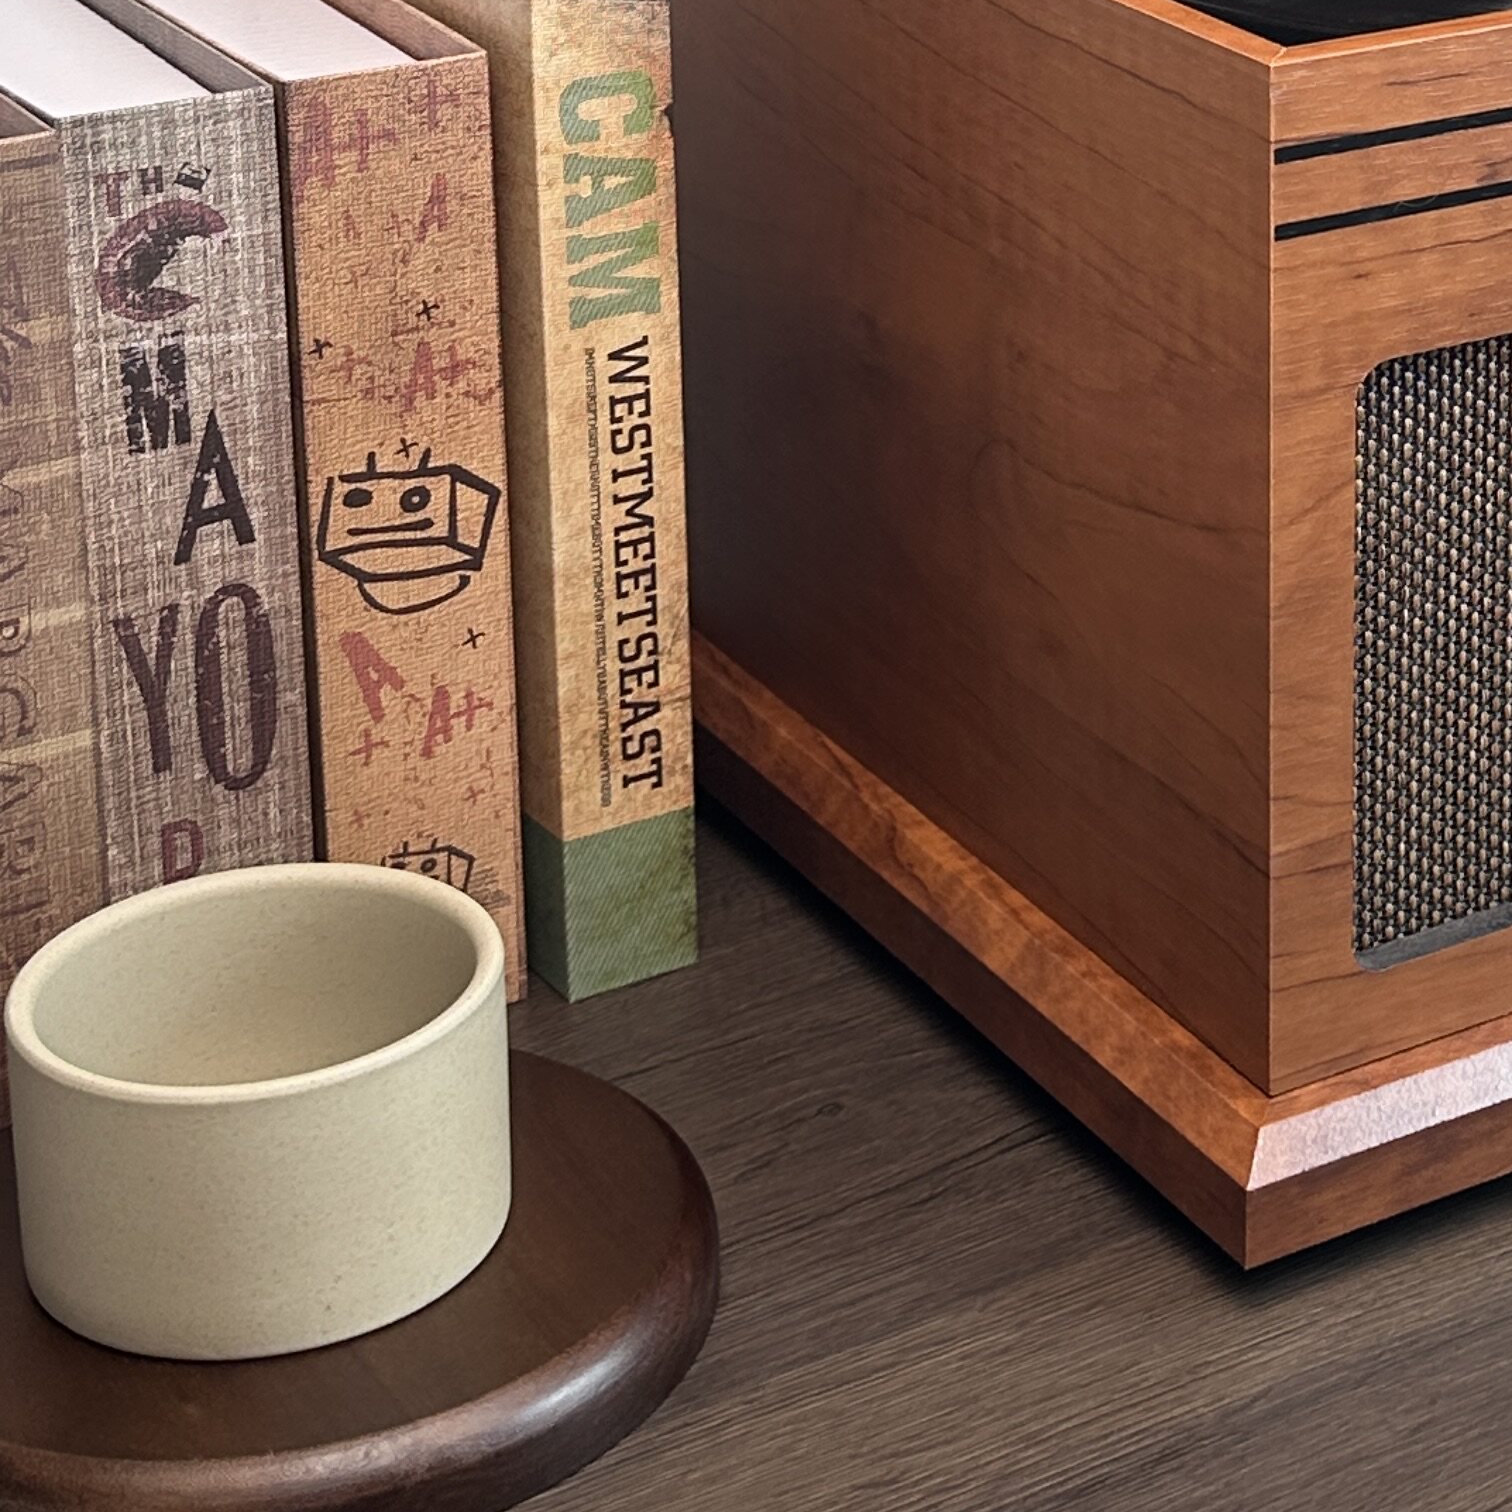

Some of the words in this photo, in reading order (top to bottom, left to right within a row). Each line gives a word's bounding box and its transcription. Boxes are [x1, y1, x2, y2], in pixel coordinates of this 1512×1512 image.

[559, 70, 662, 330] CAM
[174, 409, 256, 566] A
[608, 335, 663, 790] WESTMEETSEAST
[114, 584, 277, 791] YO
